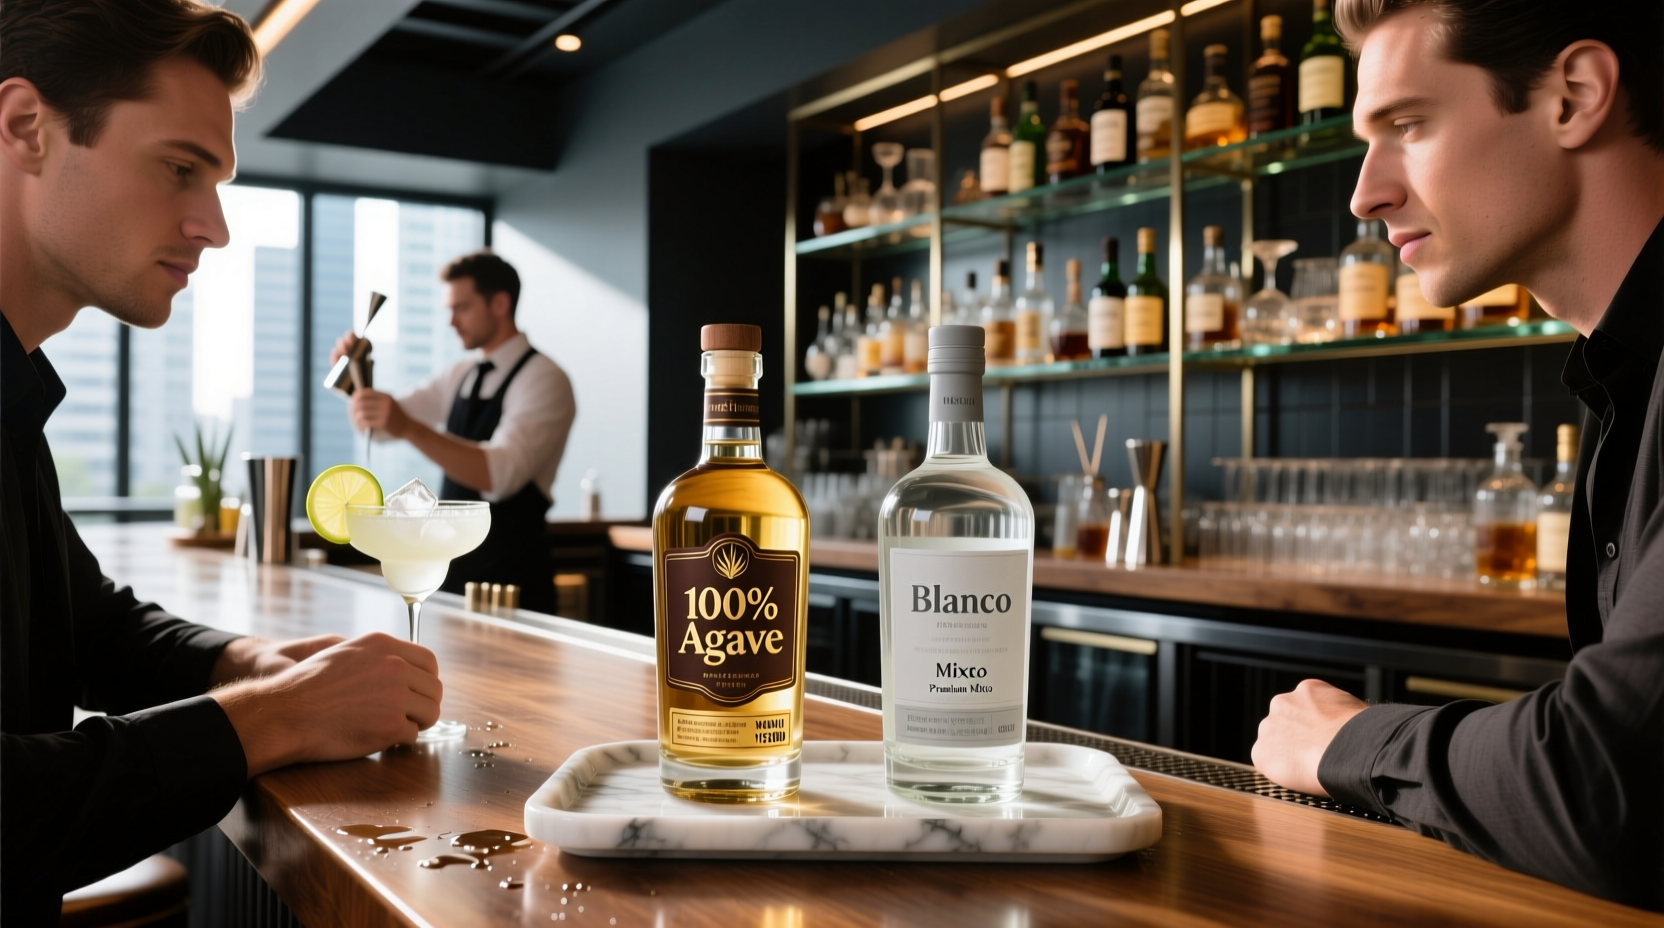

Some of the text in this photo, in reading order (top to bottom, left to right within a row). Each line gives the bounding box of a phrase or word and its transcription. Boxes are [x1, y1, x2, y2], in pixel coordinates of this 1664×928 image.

[684, 586, 778, 620] 100%
[911, 584, 1012, 614] Blanco
[678, 621, 784, 666] Agave
